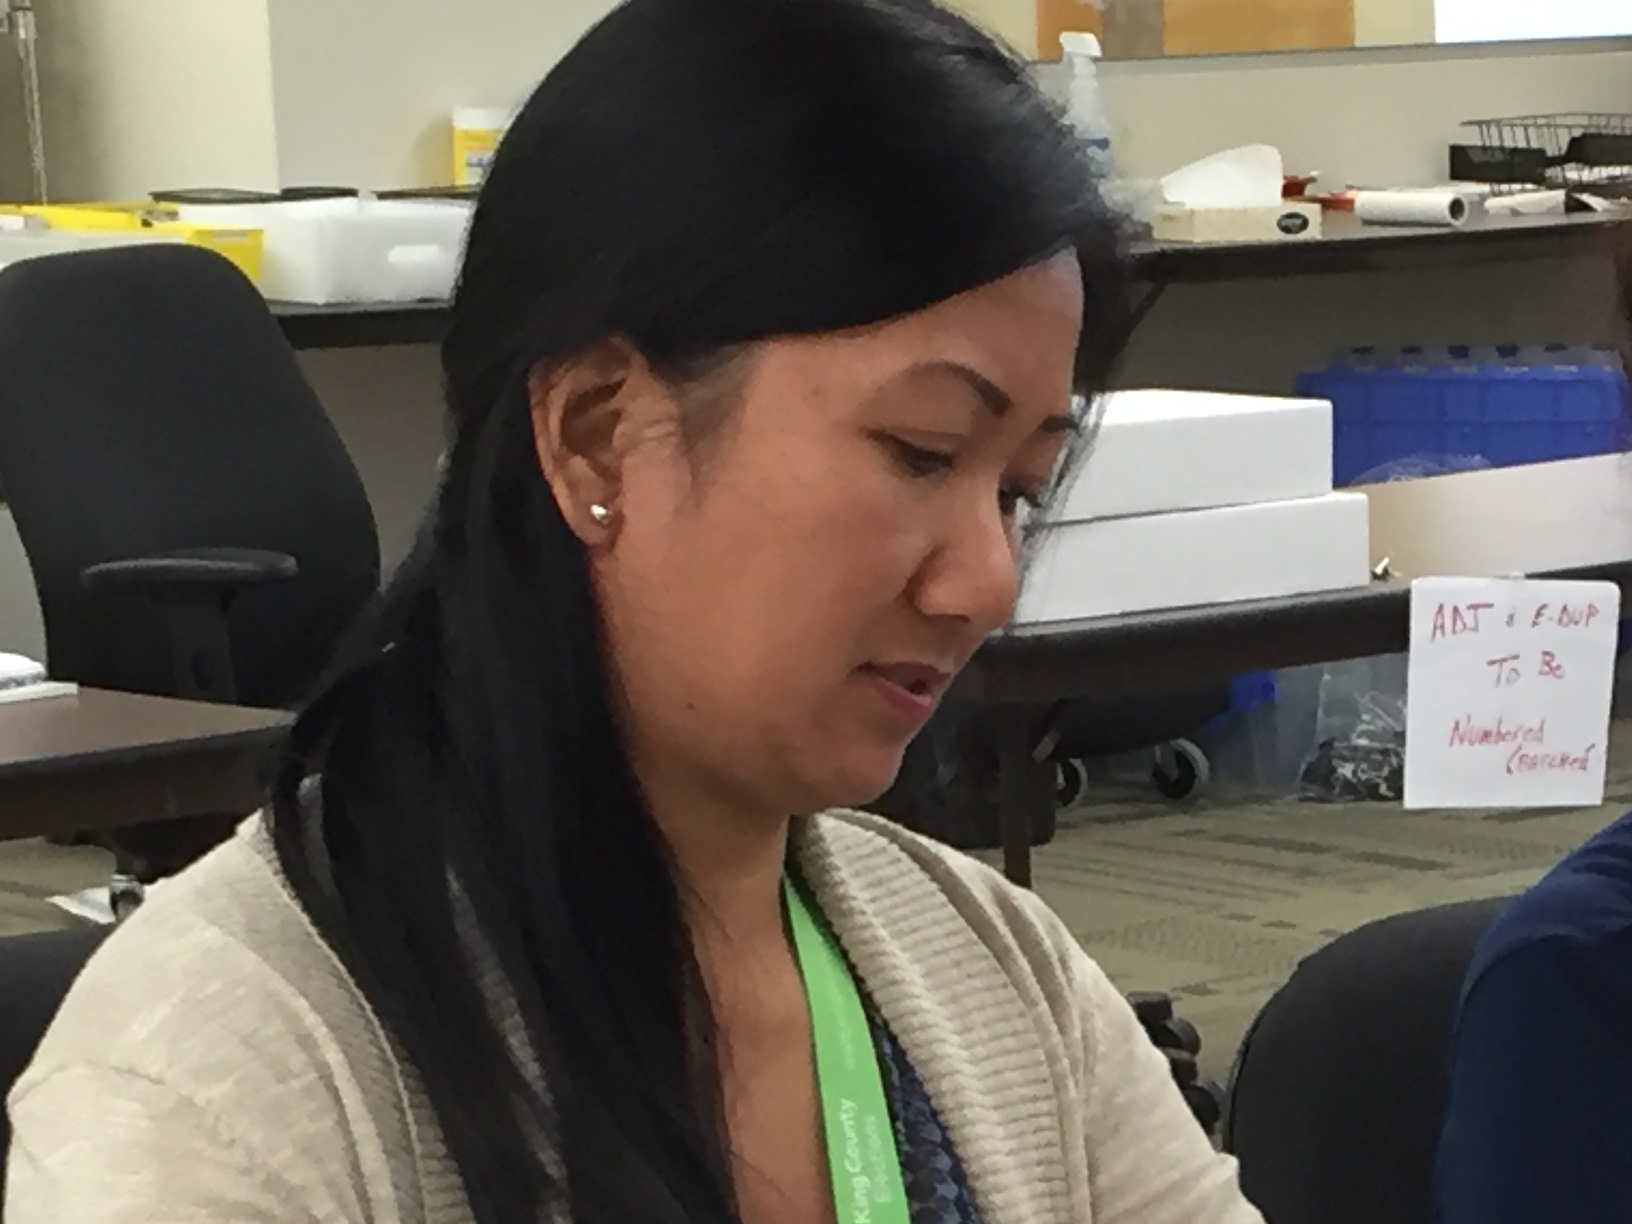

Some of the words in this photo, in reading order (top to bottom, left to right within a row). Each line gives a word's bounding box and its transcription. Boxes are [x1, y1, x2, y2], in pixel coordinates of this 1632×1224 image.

[1431, 603, 1494, 641] ADJ
[1449, 716, 1545, 747] Numbered
[839, 1098, 864, 1173] County
[863, 1114, 892, 1204] Elections
[850, 1175, 872, 1224] King
